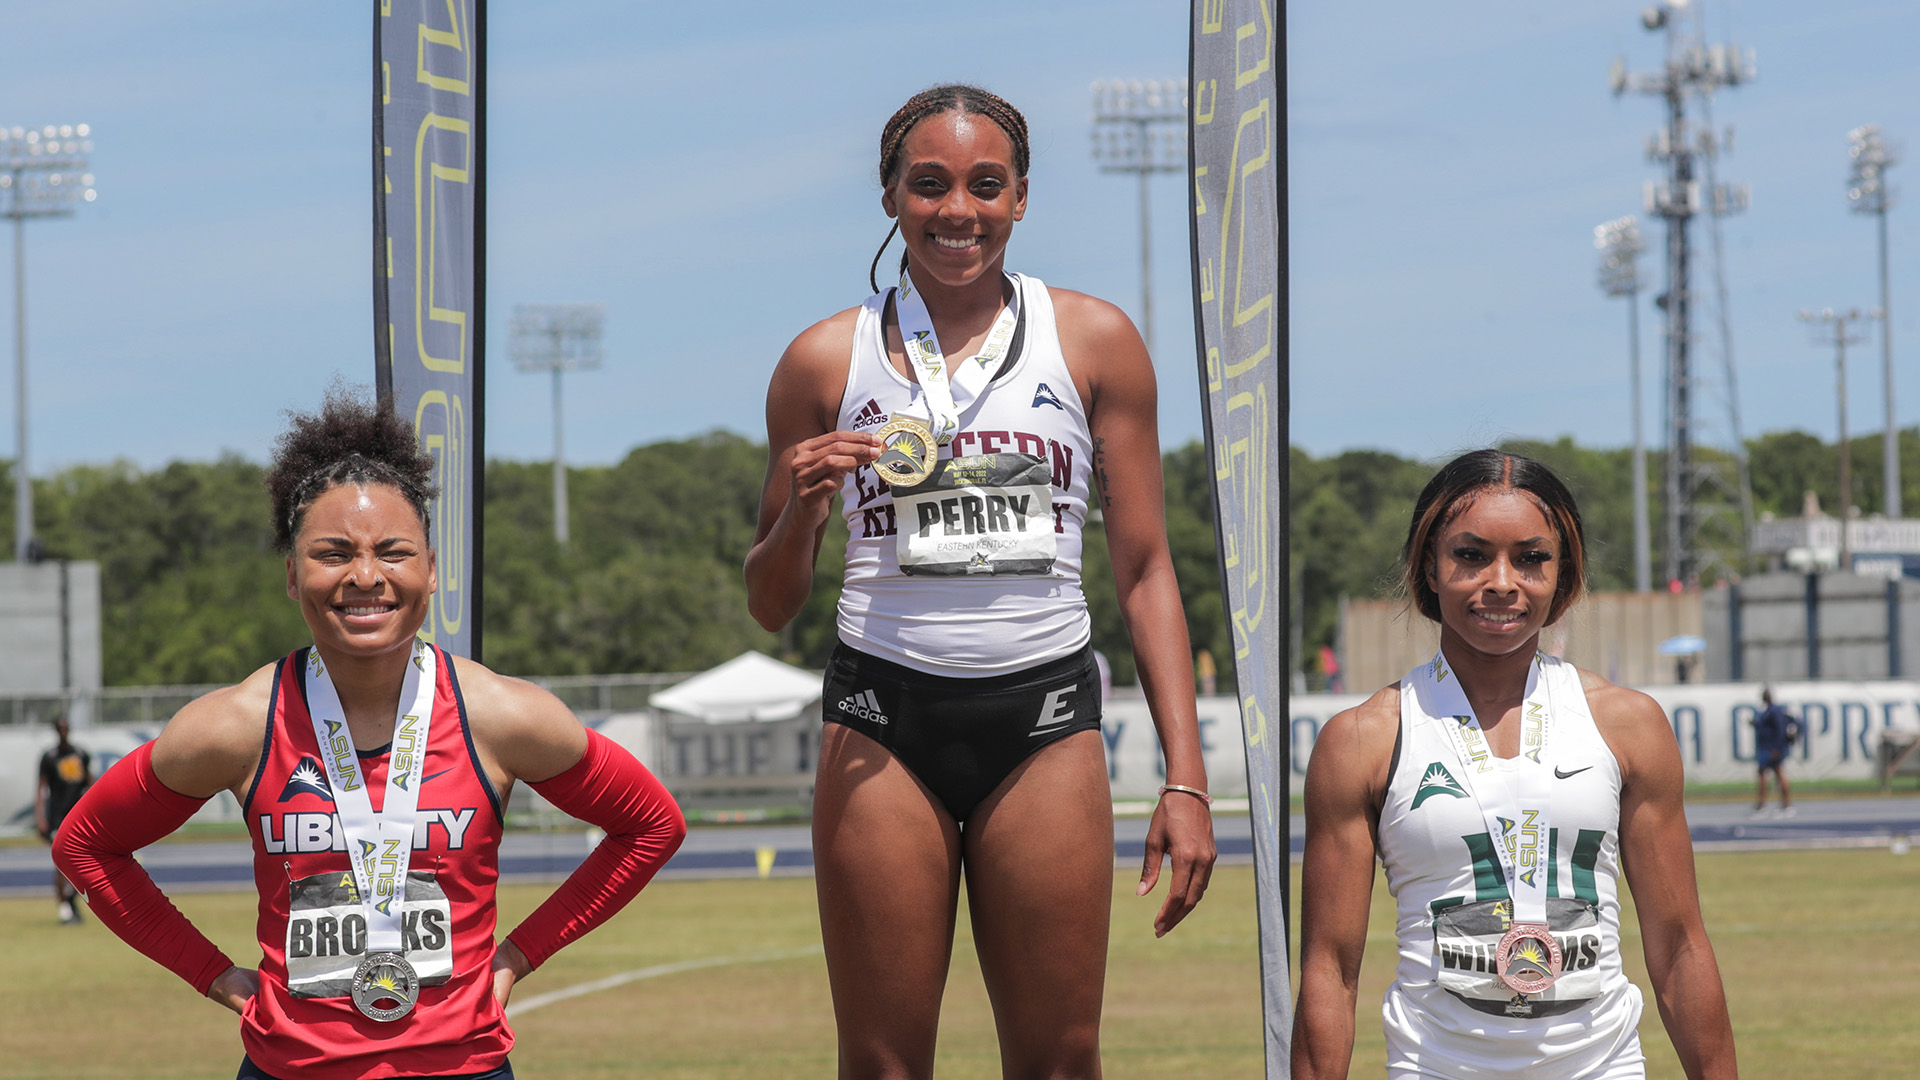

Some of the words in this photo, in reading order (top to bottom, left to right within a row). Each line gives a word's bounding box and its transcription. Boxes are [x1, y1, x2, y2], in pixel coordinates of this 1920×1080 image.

[913, 330, 943, 382] ASUN
[853, 414, 888, 430] adidas
[943, 455, 997, 472] ASUN
[917, 494, 1030, 538] PERRY
[937, 542, 974, 552] EASTERN
[976, 540, 1019, 549] KENTUCKY
[837, 699, 889, 725] adidas
[1035, 683, 1078, 728] E
[323, 719, 360, 792] ASUN
[392, 714, 419, 792] ASUN
[412, 727, 424, 782] CONFERENCE
[1452, 714, 1493, 774] ASUN
[1525, 700, 1543, 765] ASUN
[320, 730, 338, 783] CONFERENCE
[259, 808, 477, 855] LIBTY
[1519, 809, 1539, 889] ASUN
[375, 839, 401, 917] ASUN
[290, 909, 447, 958] BROKS
[1440, 934, 1599, 975] WILMS
[1499, 931, 1516, 961] OUTDOOR
[1539, 931, 1552, 944] AND
[353, 961, 372, 991] OUTDOOR
[1512, 978, 1547, 990] CHAMPION
[368, 1006, 404, 1019] CHAMPION
